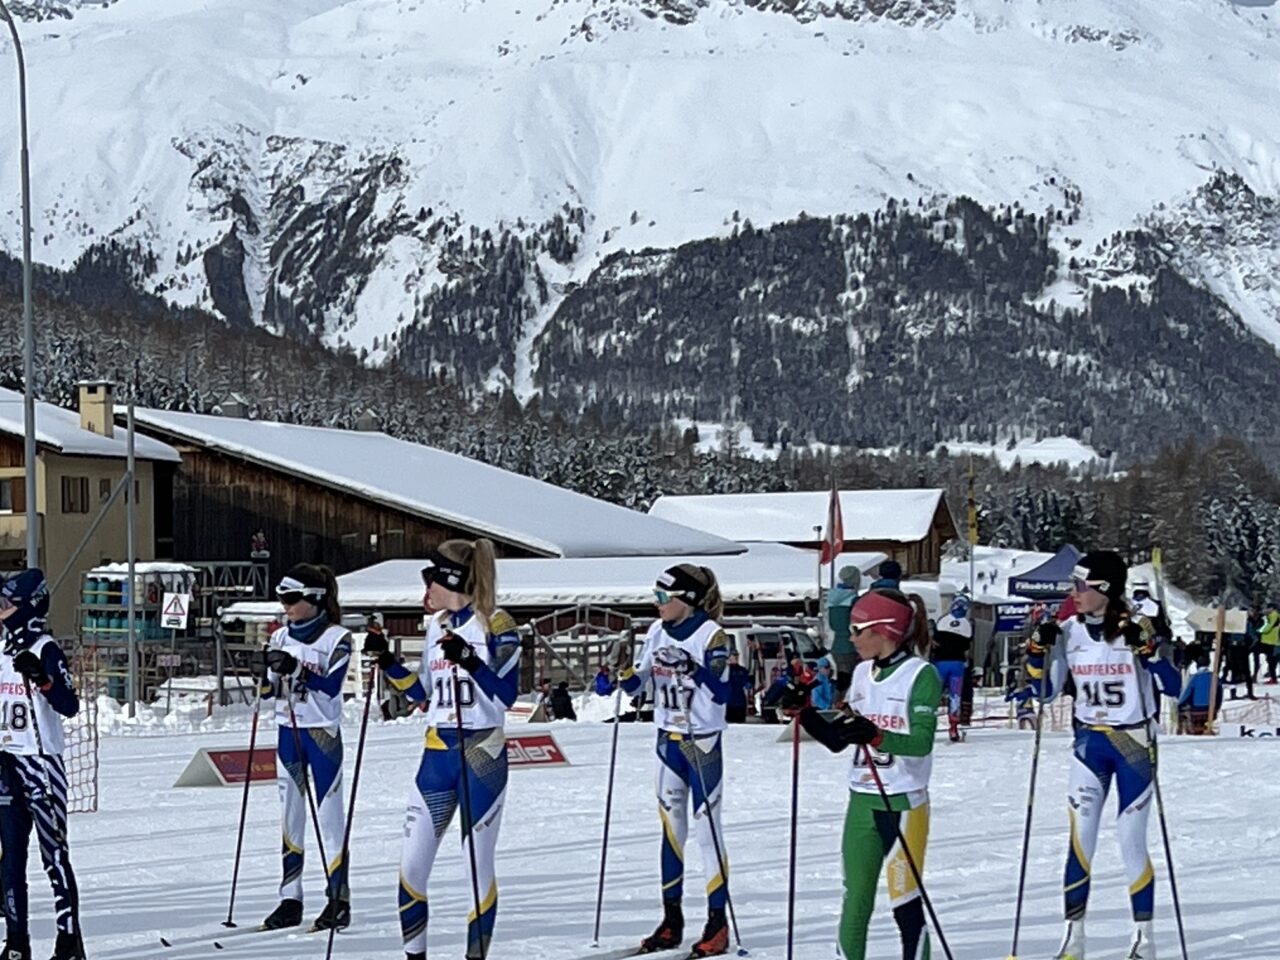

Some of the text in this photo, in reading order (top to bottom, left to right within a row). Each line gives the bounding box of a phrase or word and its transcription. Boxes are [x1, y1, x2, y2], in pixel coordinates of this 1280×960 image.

[1072, 663, 1132, 676] RAIFFEISEN
[435, 677, 475, 708] 110
[661, 684, 695, 710] 117
[1082, 681, 1125, 708] 115
